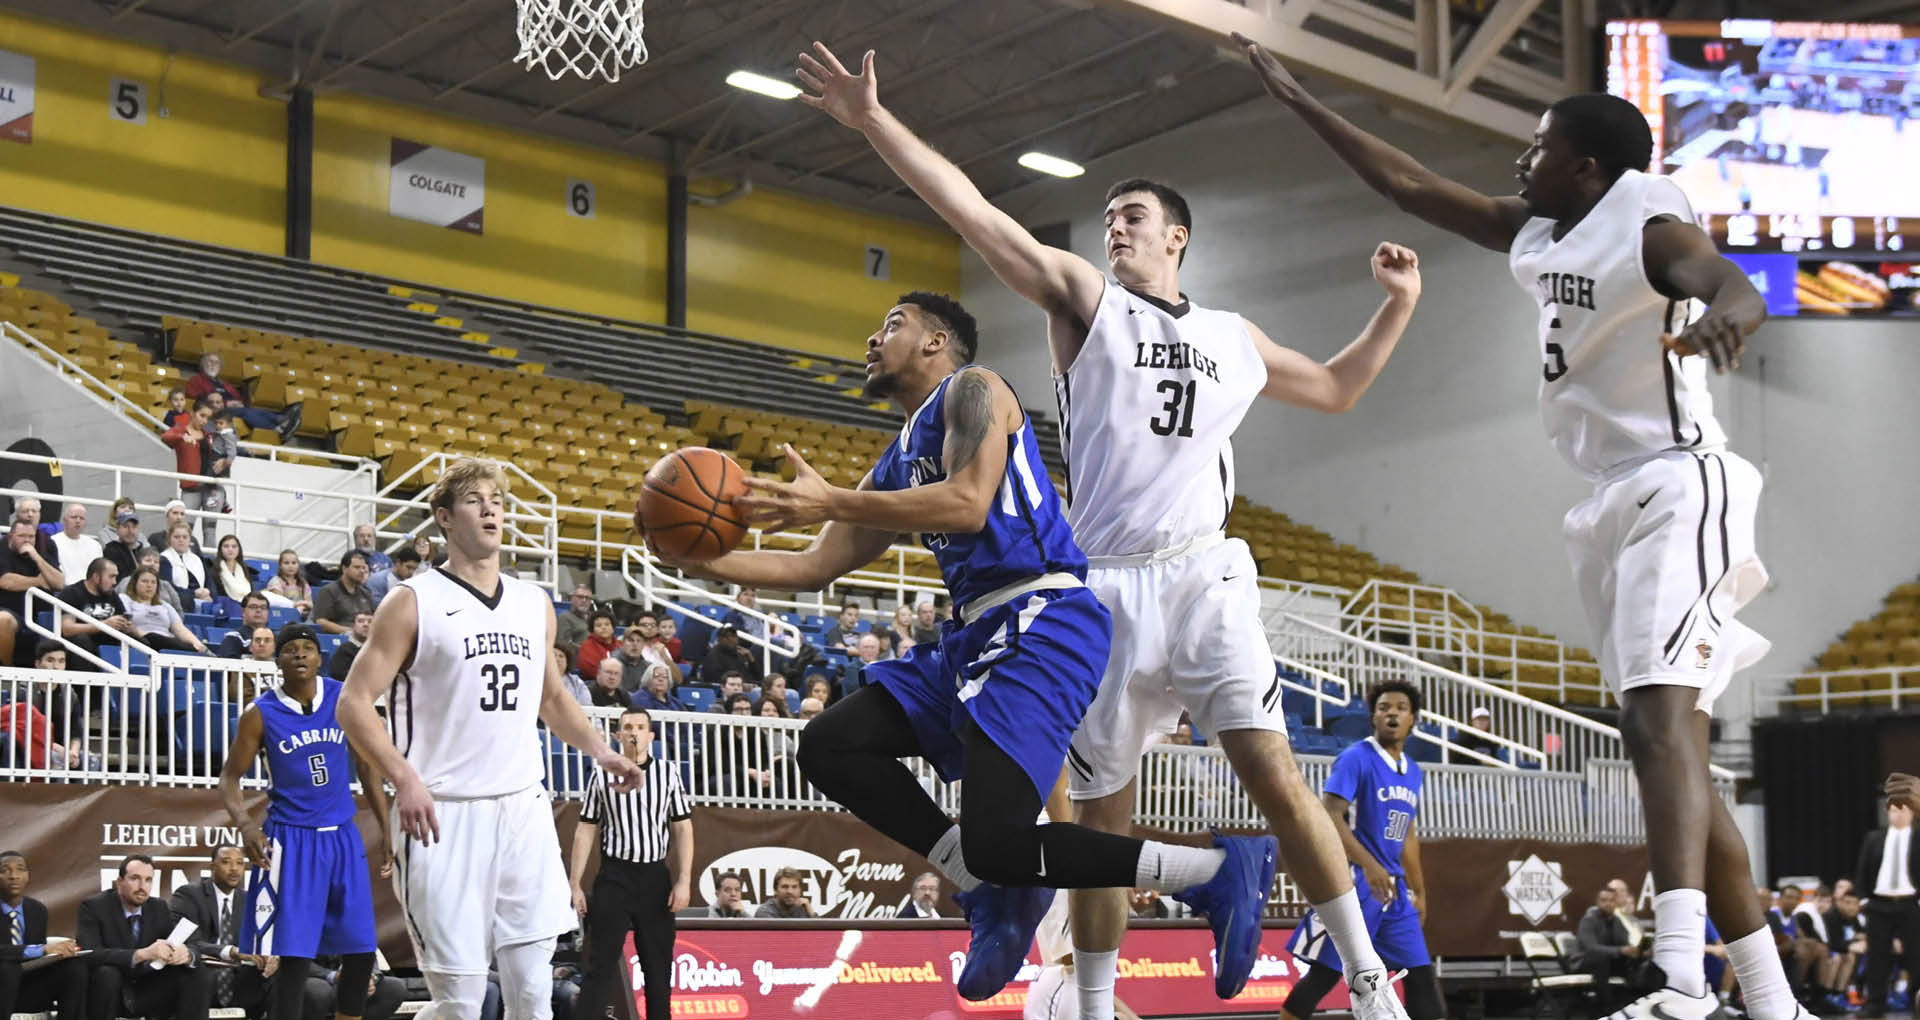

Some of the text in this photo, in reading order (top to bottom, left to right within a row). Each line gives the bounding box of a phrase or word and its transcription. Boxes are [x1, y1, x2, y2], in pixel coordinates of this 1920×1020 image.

[116, 82, 139, 120] 5
[409, 173, 467, 199] COLGATE
[571, 183, 590, 216] 6
[869, 248, 884, 277] 7
[1133, 341, 1222, 384] LEHIGH
[1150, 379, 1196, 438] 31
[463, 632, 532, 661] LEHIGH
[480, 663, 520, 712] 32
[278, 727, 345, 755] CABRINI
[308, 753, 329, 787] 5
[102, 823, 198, 848] LEHIGH
[1384, 809, 1410, 842] 30
[837, 848, 905, 882] Farm
[676, 953, 742, 992] Robin
